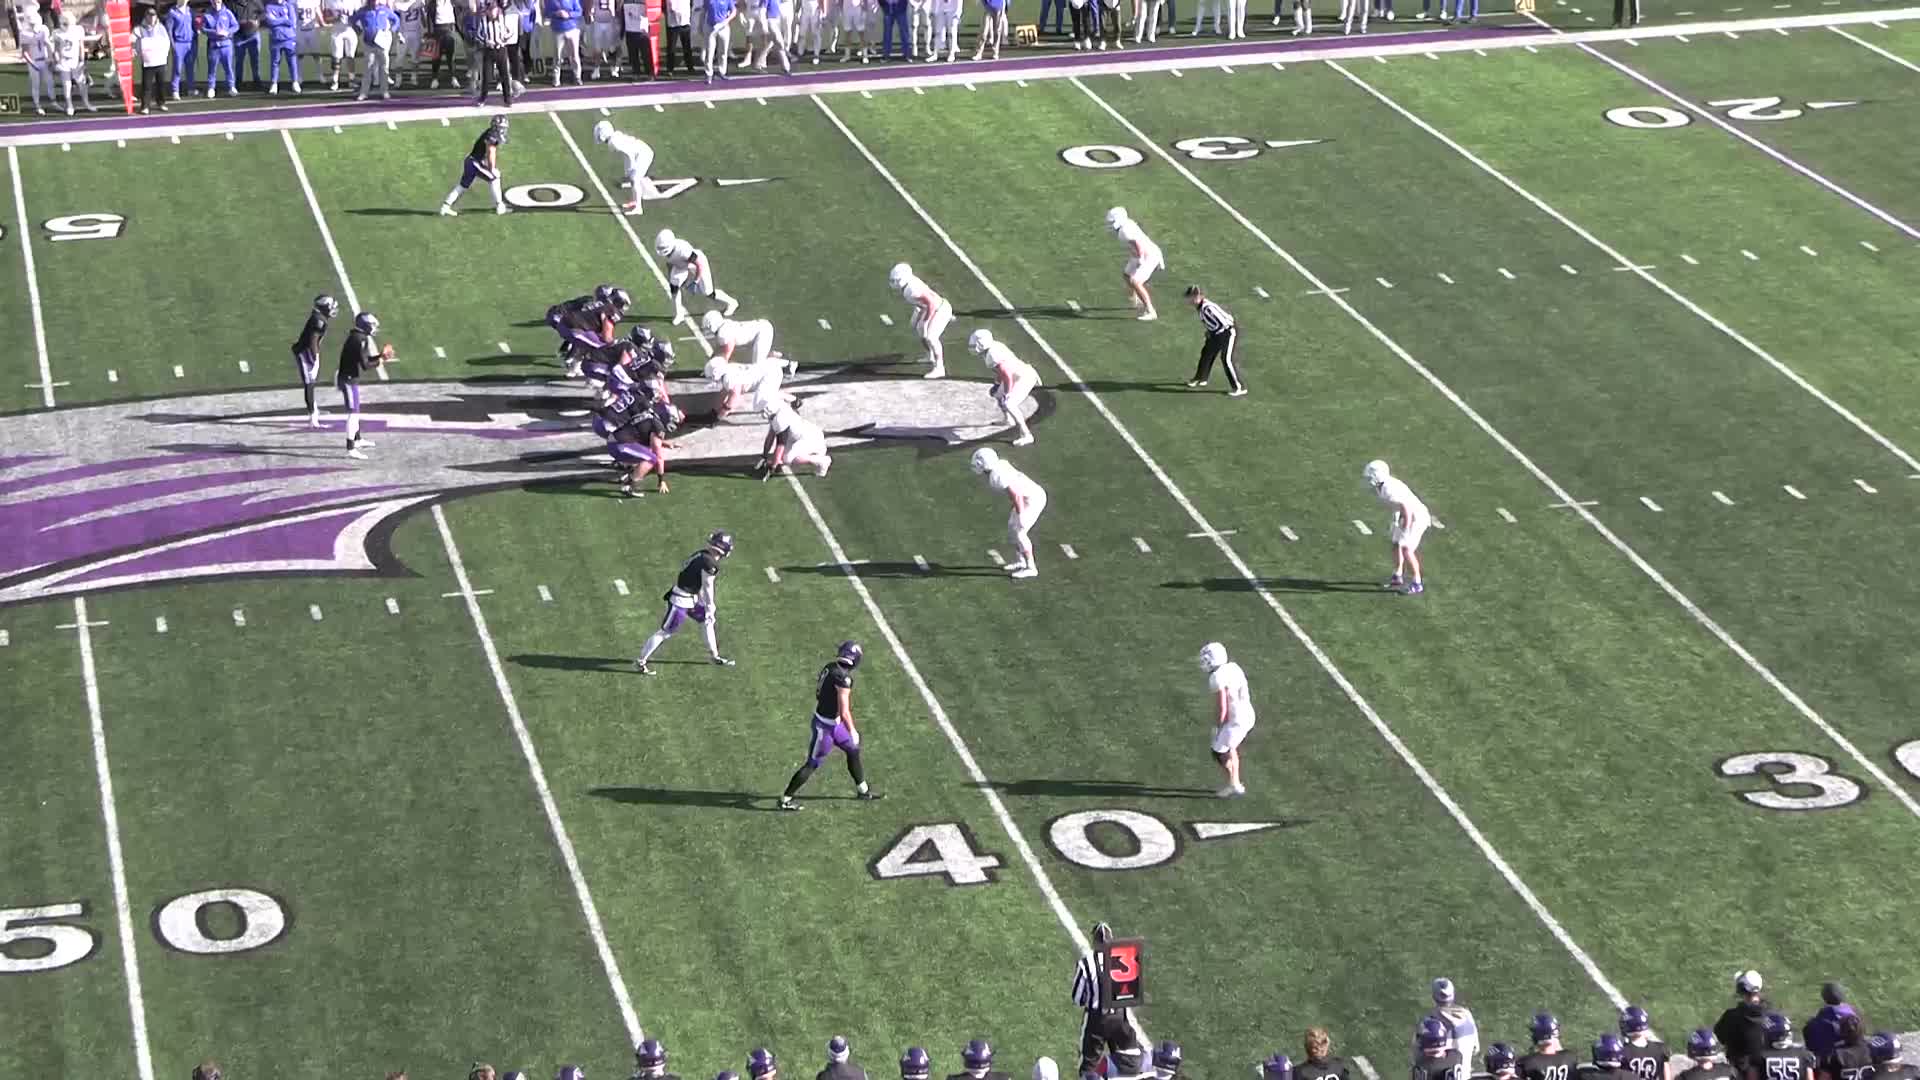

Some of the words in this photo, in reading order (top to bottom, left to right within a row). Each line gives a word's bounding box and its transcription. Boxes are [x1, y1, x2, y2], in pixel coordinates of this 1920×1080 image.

[1016, 28, 1036, 45] 30
[1110, 947, 1139, 982] 3
[1766, 1057, 1800, 1080] 55
